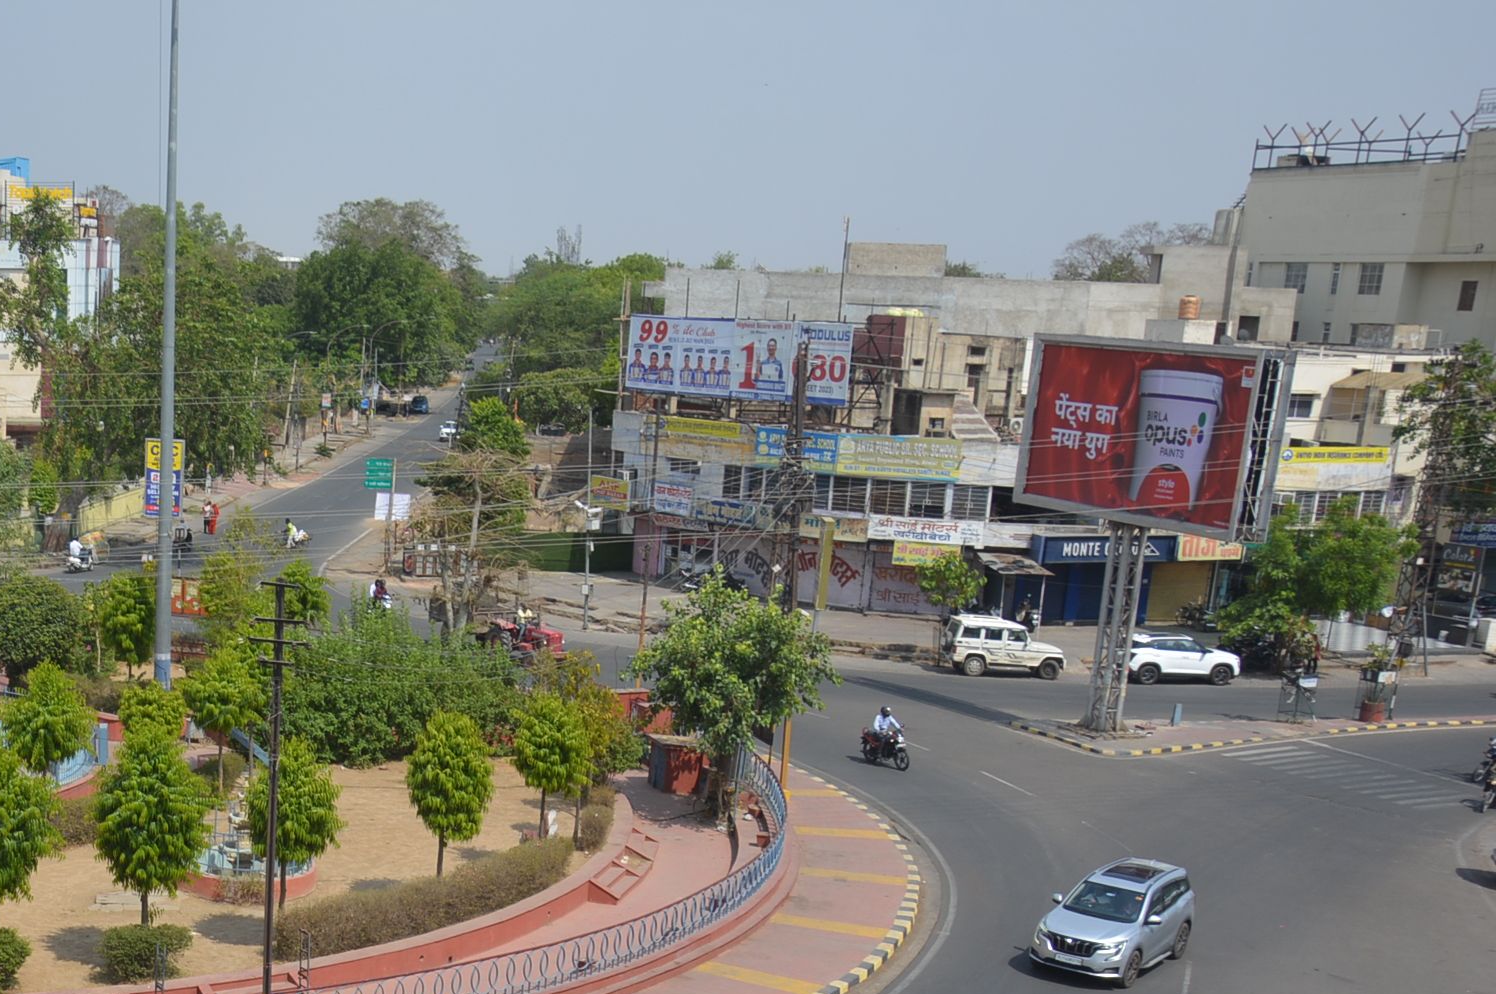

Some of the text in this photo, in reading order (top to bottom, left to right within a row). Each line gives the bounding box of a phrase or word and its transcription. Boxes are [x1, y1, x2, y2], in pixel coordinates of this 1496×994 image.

[639, 319, 668, 343] 99
[800, 325, 852, 341] MODULUS
[1055, 393, 1118, 428] पेंट्स का
[1147, 410, 1168, 422] BIRLA
[1051, 427, 1110, 459] नया युग
[1159, 446, 1184, 459] PAINTS
[1062, 542, 1101, 557] MONTE
